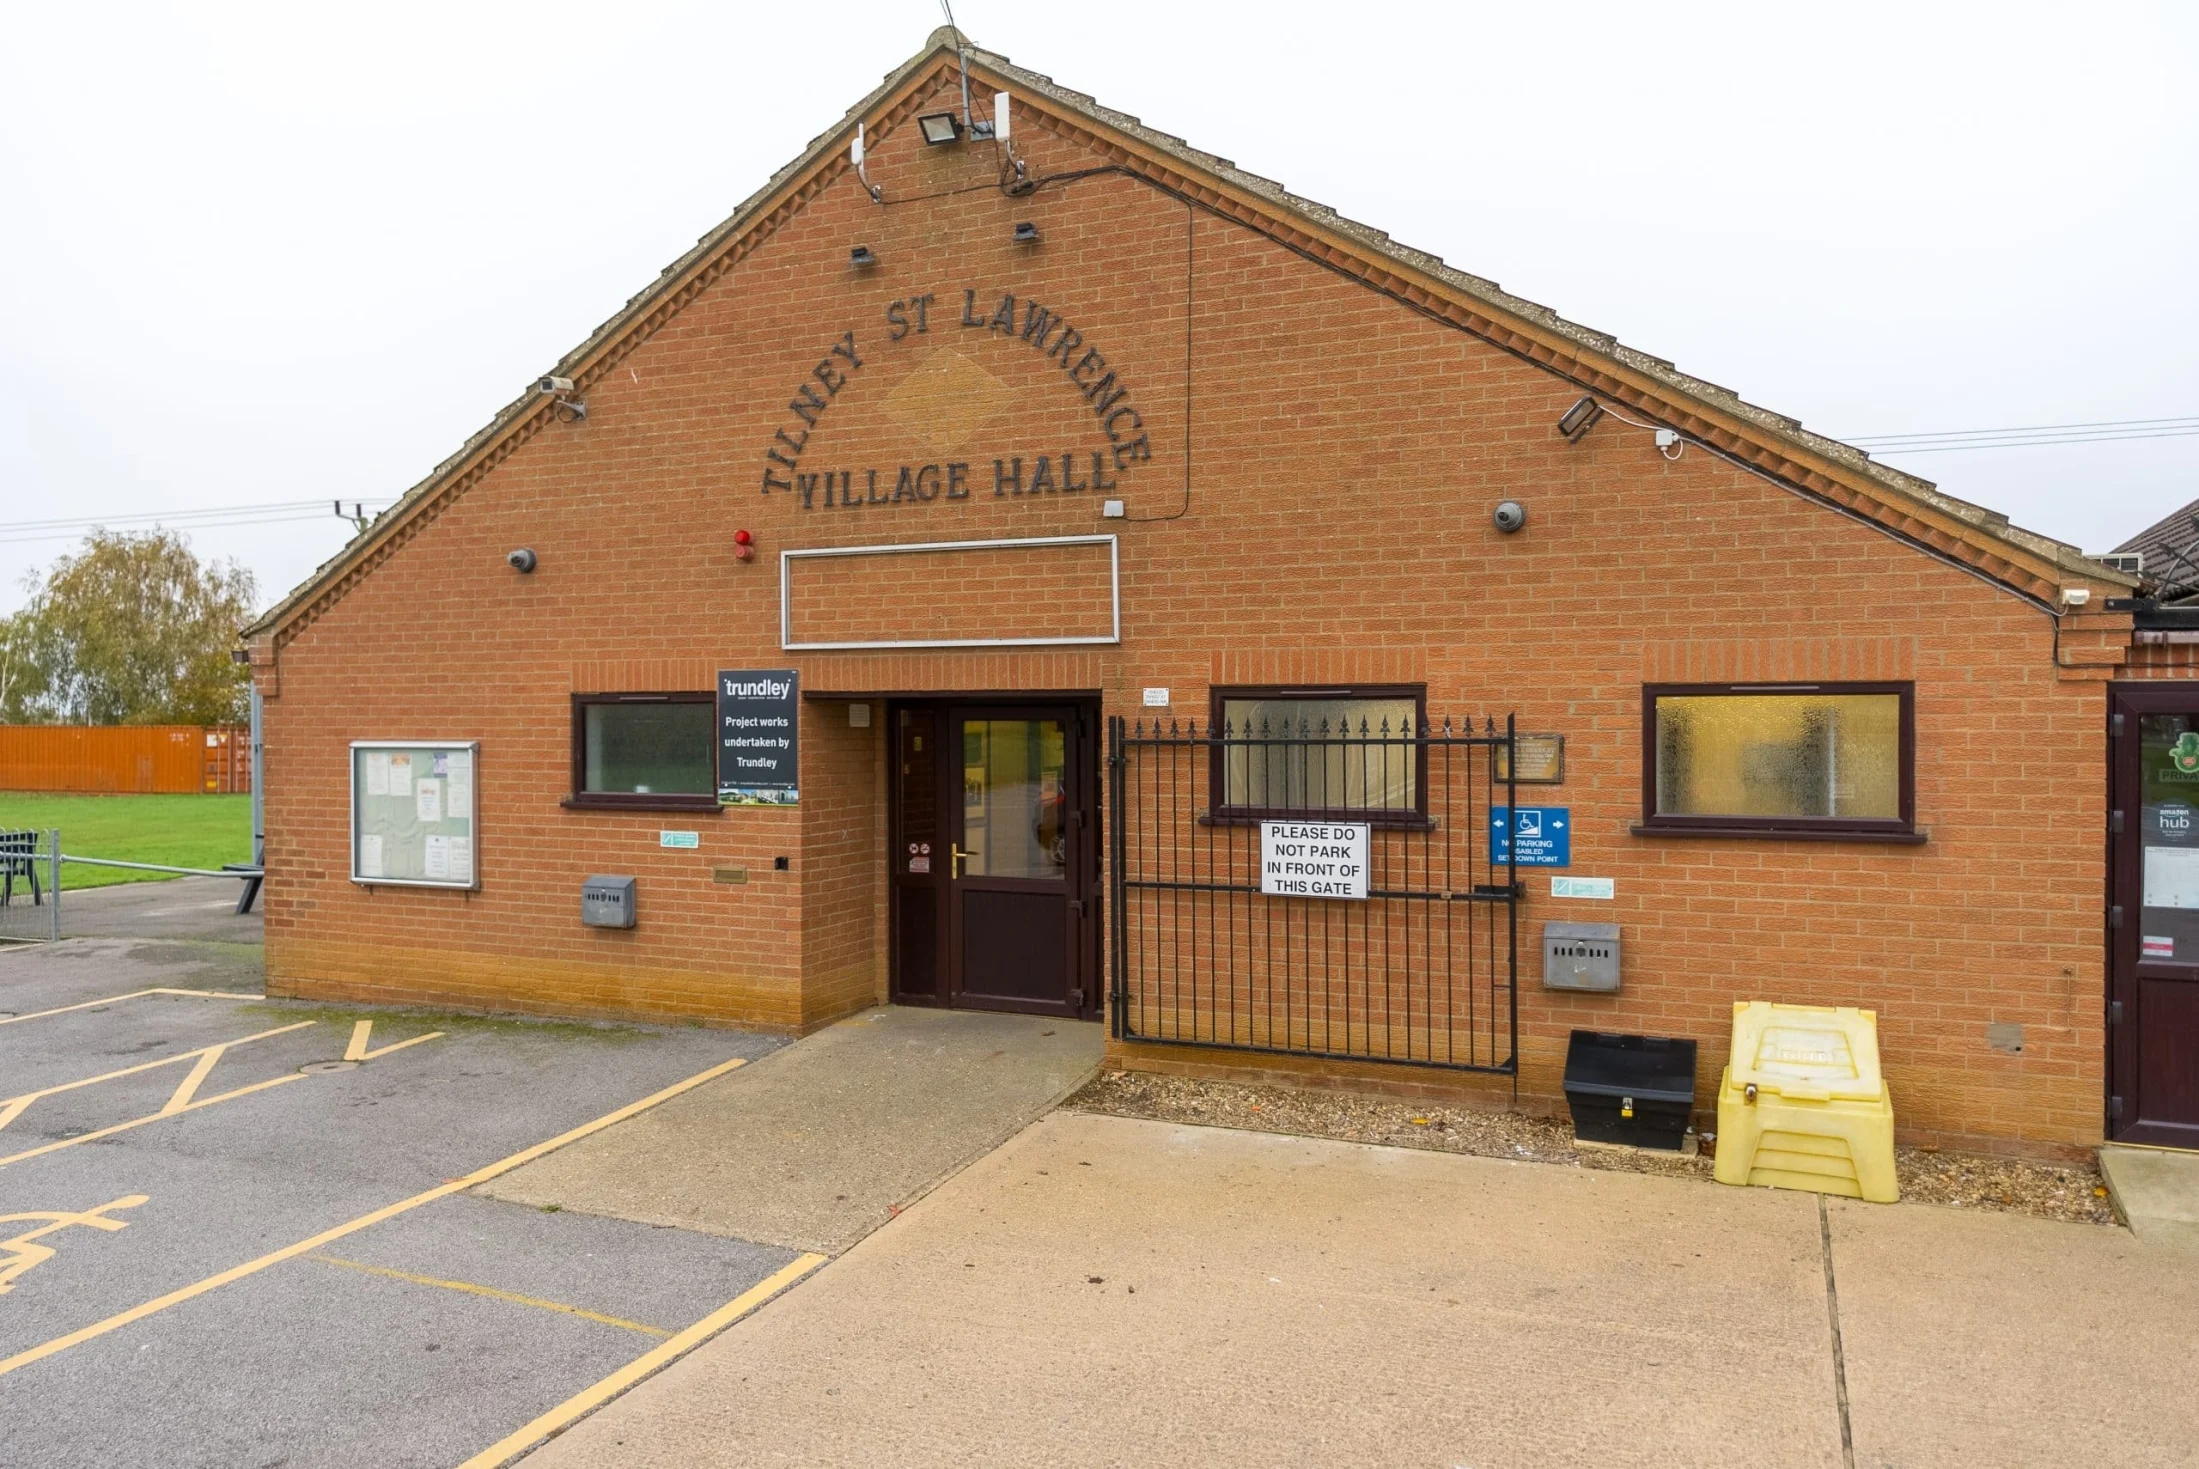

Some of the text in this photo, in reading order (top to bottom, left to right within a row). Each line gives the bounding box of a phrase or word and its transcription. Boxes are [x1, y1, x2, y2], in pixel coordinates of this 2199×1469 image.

[761, 288, 1151, 494] TILNEY ST LAWRENCE
[797, 451, 1116, 508] VILLAGE HALL
[725, 678, 790, 700] trundley
[725, 717, 789, 729] Project works
[724, 737, 790, 750] undertaken by
[736, 757, 778, 769] Trundley
[2162, 771, 2199, 780] PRIVA
[2160, 815, 2190, 829] hub
[1271, 826, 1355, 841] PLEASE DO
[1516, 839, 1553, 848] PARKING
[1275, 844, 1352, 859] NOT PARK
[1536, 855, 1559, 863] POINT
[1267, 861, 1361, 877] IN FRONT OF
[1275, 879, 1352, 895] THIS GATE
